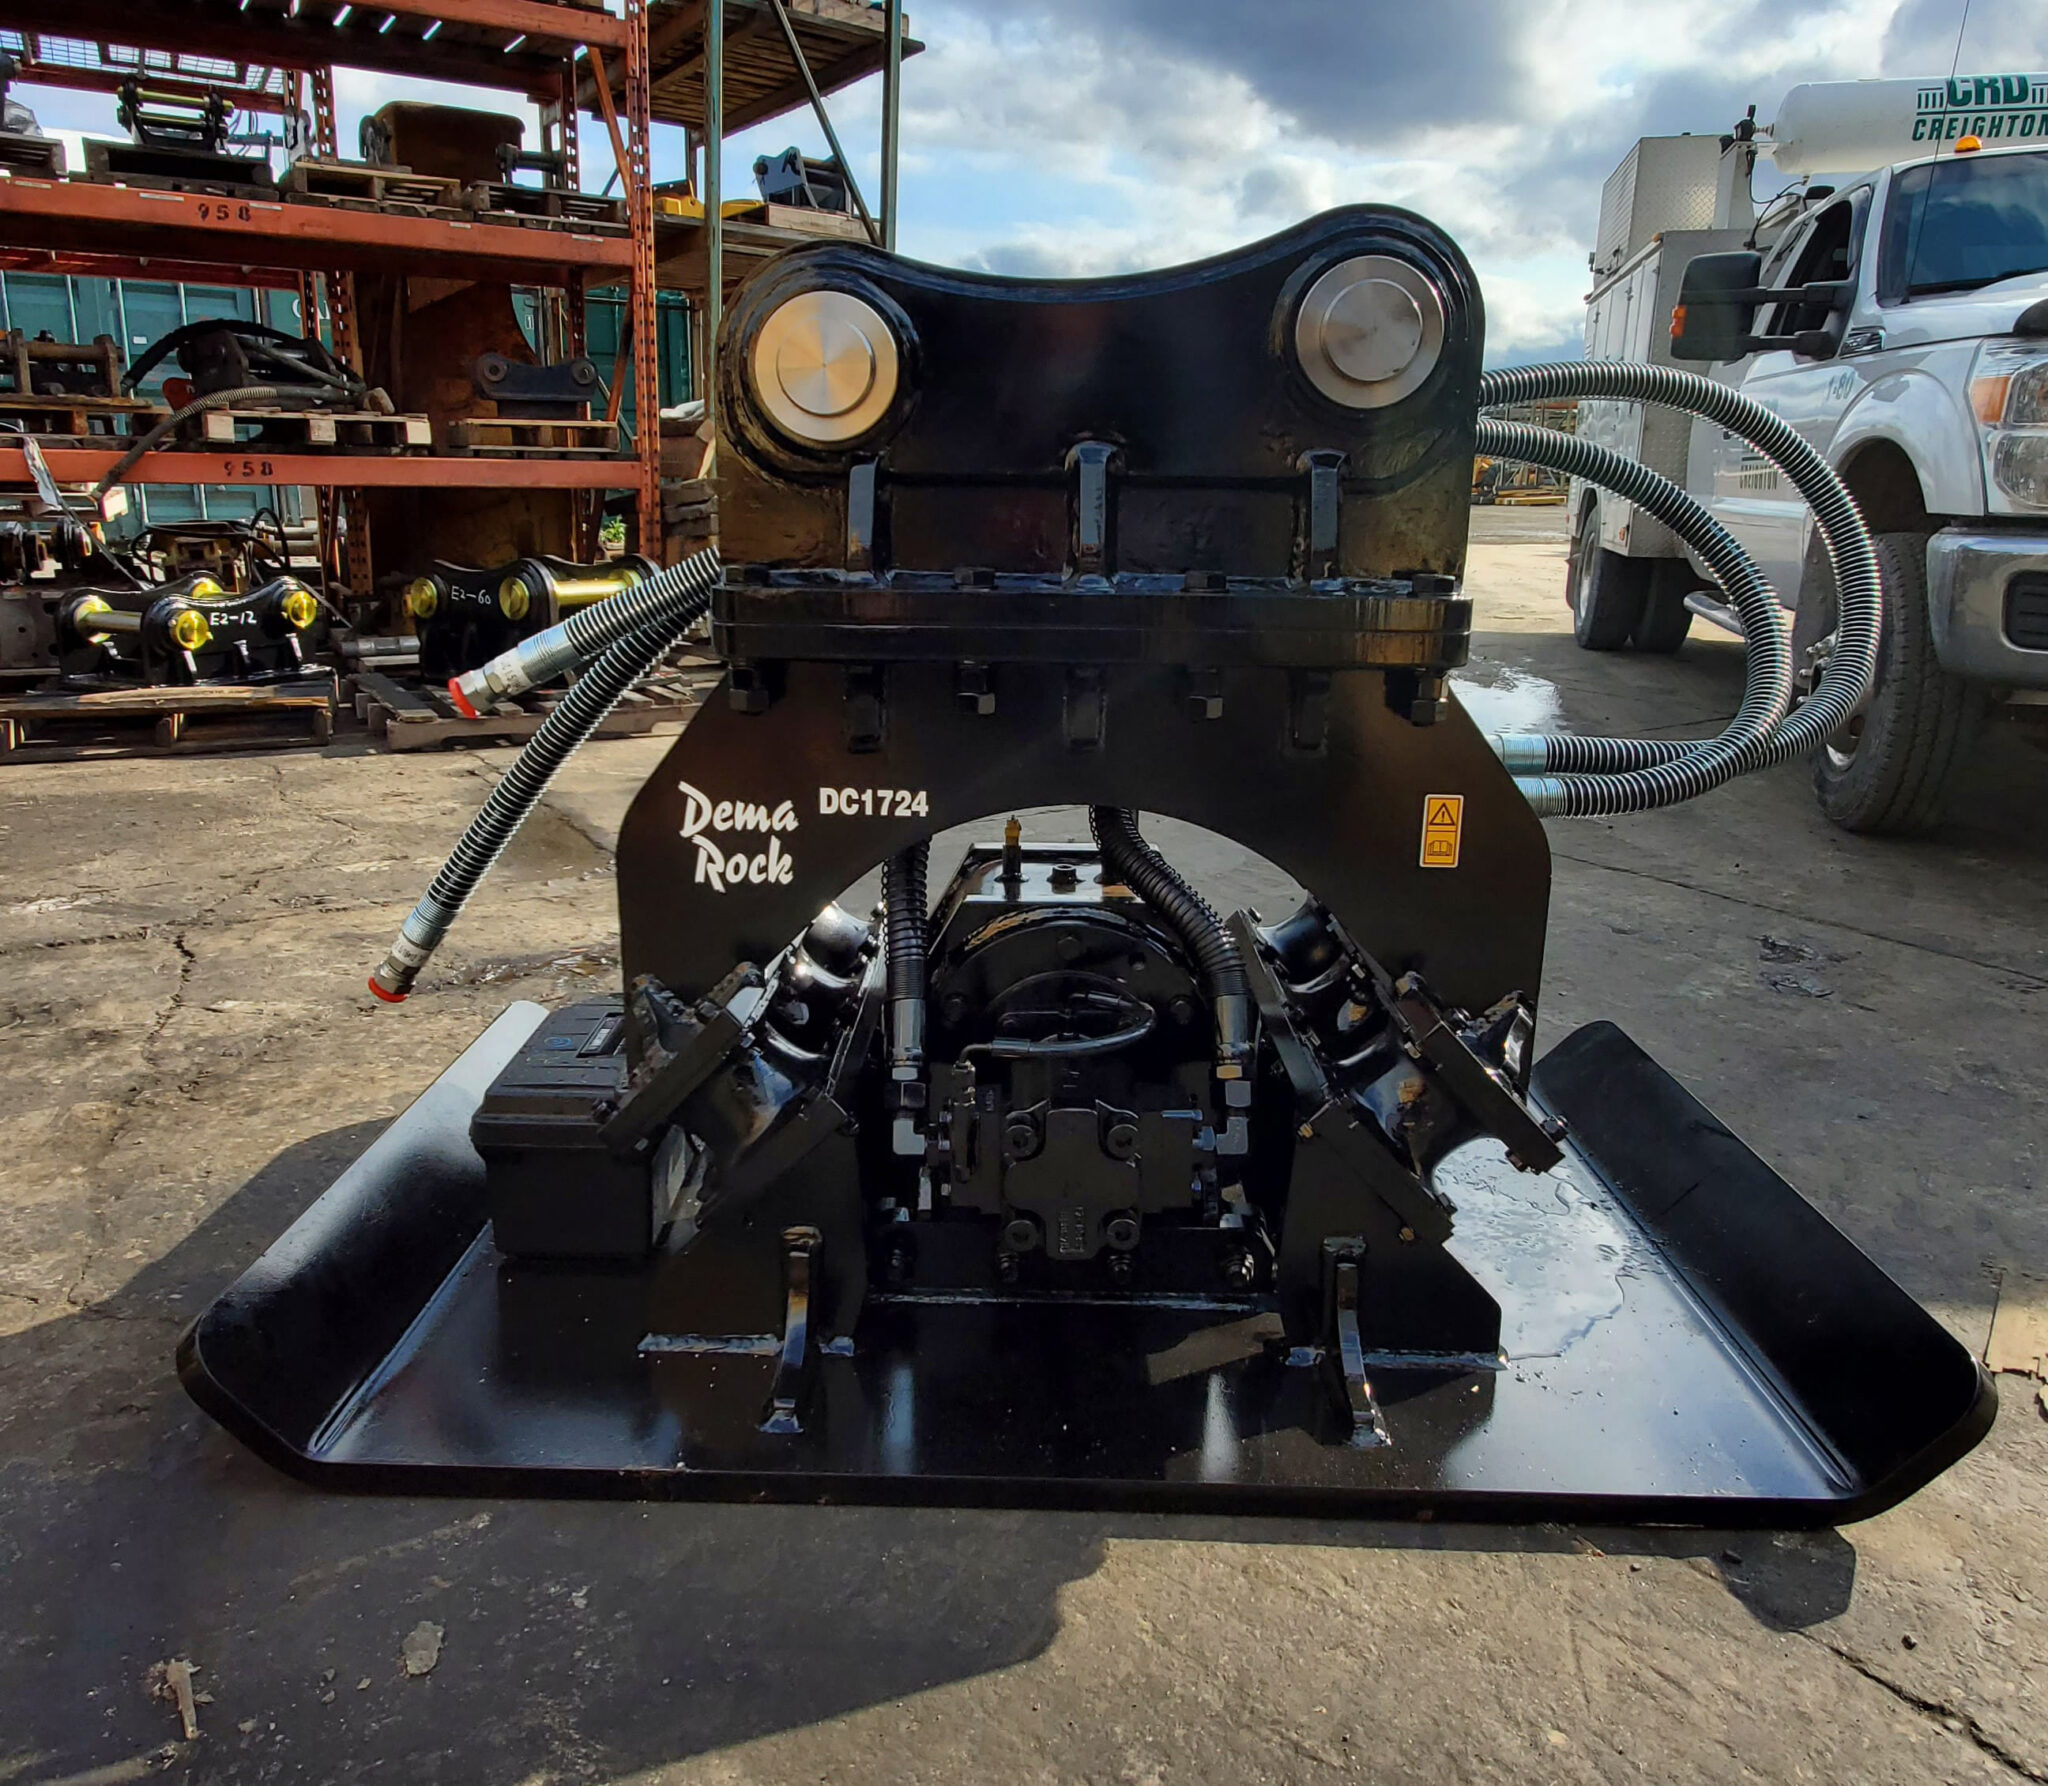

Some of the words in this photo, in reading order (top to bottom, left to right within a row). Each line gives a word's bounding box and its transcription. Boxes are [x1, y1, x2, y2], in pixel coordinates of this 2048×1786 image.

[1946, 75, 2029, 107] CRD
[1912, 114, 2048, 141] CREIGHTON
[678, 781, 799, 838] Dema
[819, 787, 929, 817] DC1724
[692, 834, 794, 894] Rock
